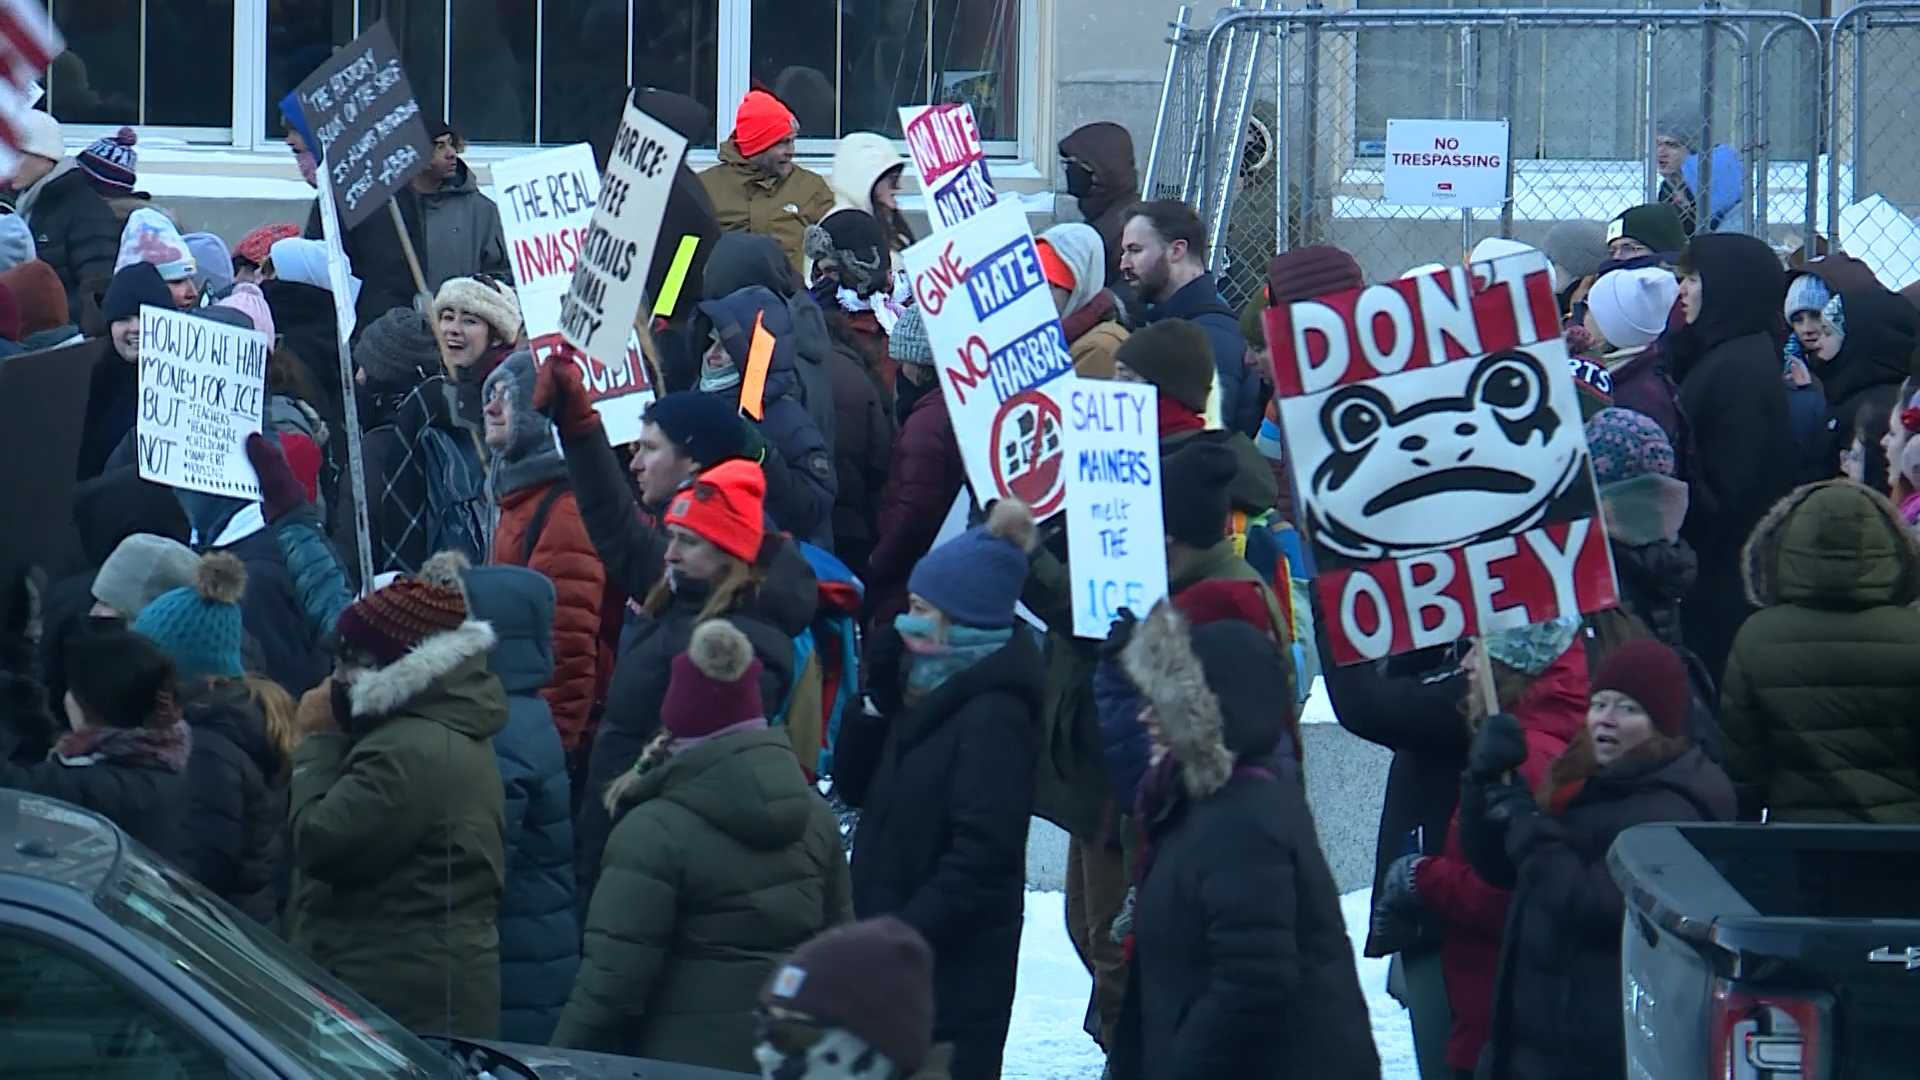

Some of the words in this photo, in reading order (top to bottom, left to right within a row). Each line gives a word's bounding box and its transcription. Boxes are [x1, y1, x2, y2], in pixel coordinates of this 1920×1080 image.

[634, 136, 667, 178] ICE:
[908, 119, 941, 177] NO
[929, 103, 982, 164] HATE
[1392, 152, 1500, 168] TRESPASSING
[1434, 137, 1459, 150] NO
[504, 178, 548, 223] THE
[547, 169, 597, 219] REAL
[916, 240, 972, 317] GIVE
[970, 242, 1039, 314] HATE
[143, 312, 181, 357] HOW
[185, 321, 206, 363] DO
[211, 332, 231, 368] WE
[236, 335, 265, 379] HAVE
[1290, 252, 1549, 395] DON'T
[142, 356, 197, 401] MONEY
[201, 375, 226, 409] FOR
[231, 384, 261, 418] ICE
[946, 335, 991, 406] NO
[990, 325, 1072, 401] HARBOR
[1568, 359, 1609, 393] RTS
[143, 387, 186, 427] BUT
[1071, 391, 1147, 435] SALTY
[139, 433, 177, 475] NOT
[1078, 449, 1151, 486] MAINERS
[1087, 579, 1144, 619] ICE
[1340, 517, 1592, 661] OBEY
